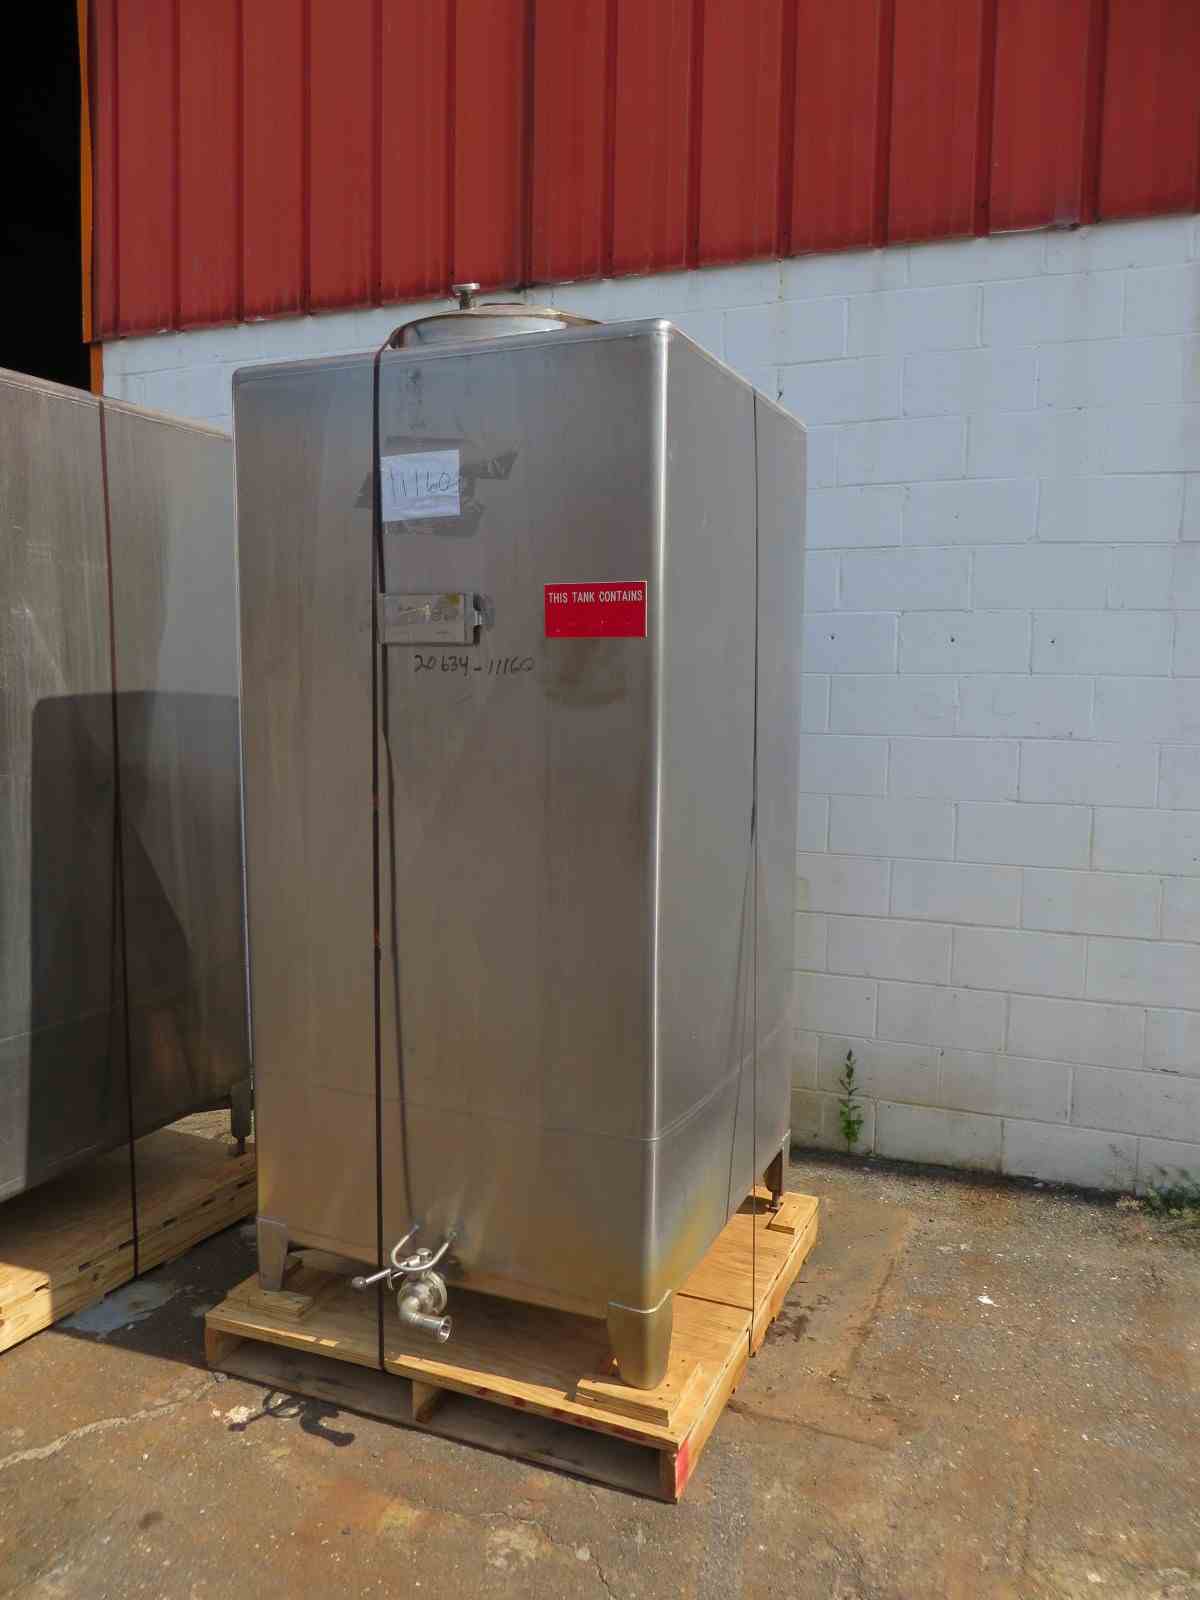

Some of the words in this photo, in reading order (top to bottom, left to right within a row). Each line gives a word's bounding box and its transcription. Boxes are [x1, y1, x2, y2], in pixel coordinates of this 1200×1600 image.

[548, 592, 568, 604] THIS
[572, 591, 595, 603] TANK
[599, 589, 643, 603] CONTAINS
